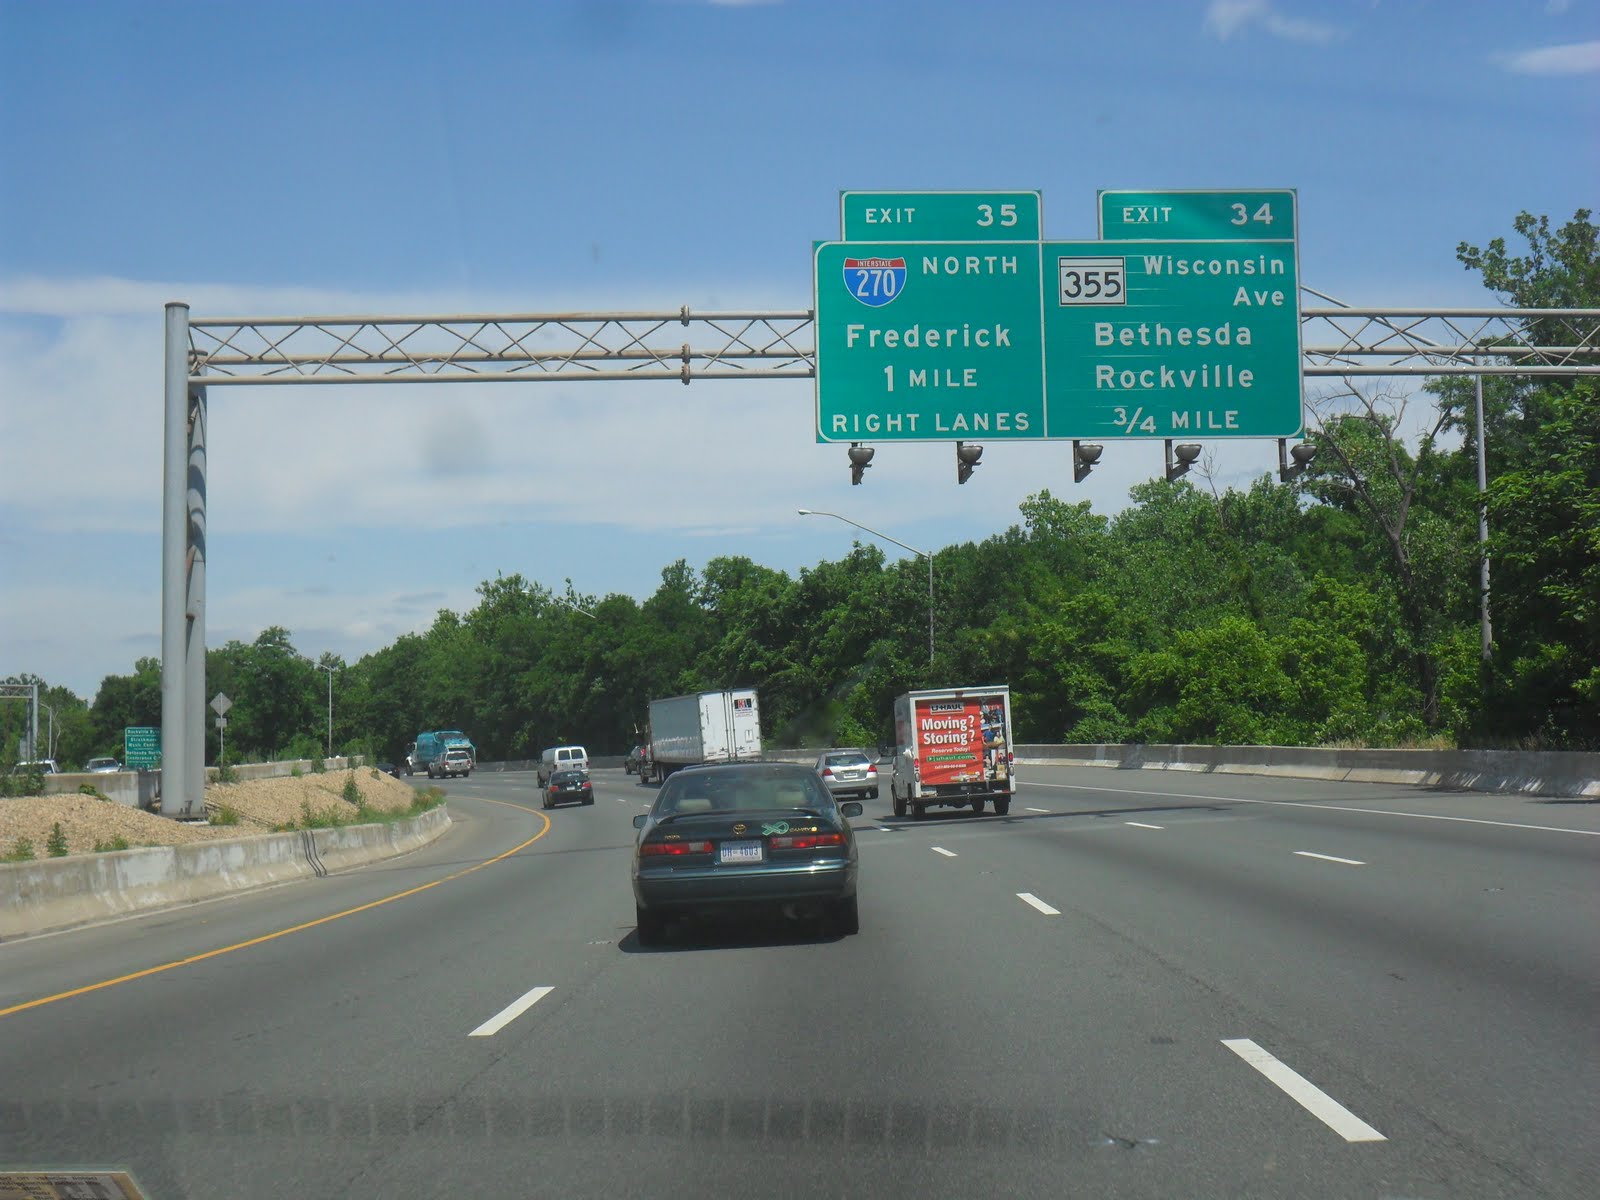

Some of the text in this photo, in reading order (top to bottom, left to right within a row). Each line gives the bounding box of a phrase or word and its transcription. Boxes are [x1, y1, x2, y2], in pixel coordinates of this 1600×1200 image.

[865, 204, 1018, 226] EXIT 35
[1123, 202, 1274, 225] EXIT 34
[923, 256, 1018, 275] NORTH
[1144, 255, 1285, 276] Wisconsin
[856, 269, 895, 297] 270
[1064, 271, 1121, 298] 355
[1233, 287, 1285, 306] Ave
[847, 324, 1011, 348] Frederick
[1095, 322, 1252, 346] Bethesda
[884, 366, 978, 391] 1 MILE
[1096, 364, 1254, 389] Rockville
[833, 412, 1030, 433] RIGHT LANES
[1114, 407, 1240, 434] 3/4 MILE
[922, 716, 975, 732] Moving?
[924, 730, 976, 745] Storing?
